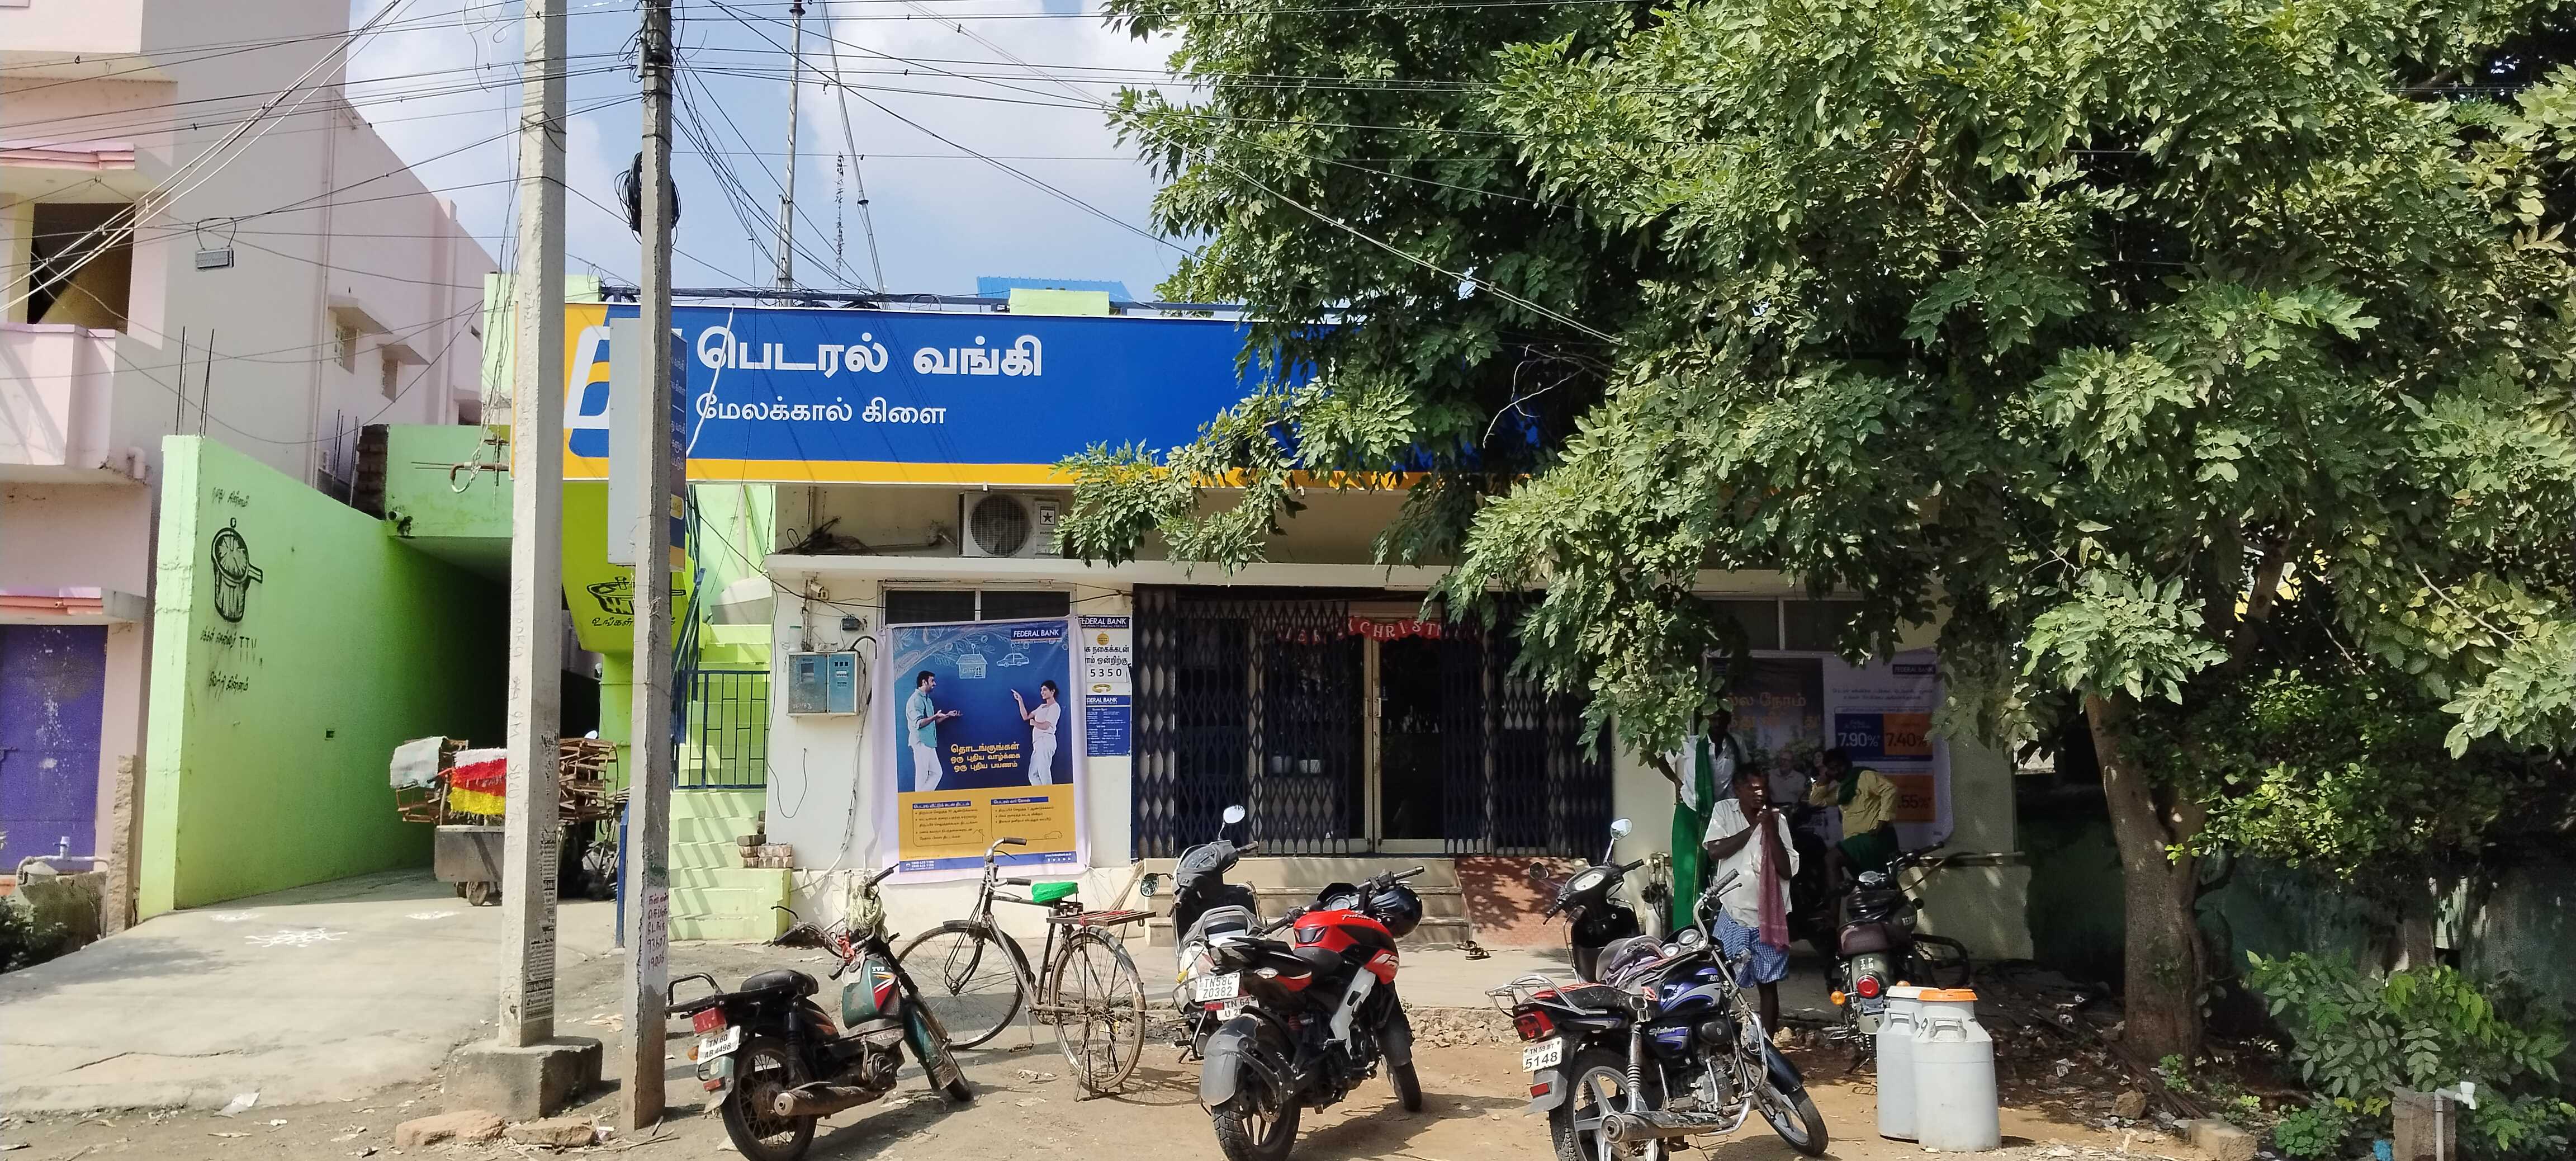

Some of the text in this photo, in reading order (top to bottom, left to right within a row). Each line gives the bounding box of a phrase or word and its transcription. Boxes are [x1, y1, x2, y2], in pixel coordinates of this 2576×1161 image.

[697, 325, 1043, 379] பெடரல் வங்கி
[696, 392, 946, 424] மேலக்கால் கிளை
[239, 636, 257, 649] TTV
[1092, 644, 1130, 654] நகைக்கடன்
[950, 741, 1020, 755] தொடங்குங்கள்
[967, 753, 984, 762] புதிய
[987, 753, 1021, 761] வாழ்க்கை
[970, 762, 988, 771] புதிய
[1897, 794, 1931, 810] .55%
[1205, 976, 1234, 988] TN58C
[1202, 986, 1233, 999] Z0382
[1225, 998, 1250, 1008] TN 64
[709, 1033, 728, 1047] TN 60
[704, 1042, 731, 1060] AB 4498
[1525, 1051, 1558, 1069] 5148
